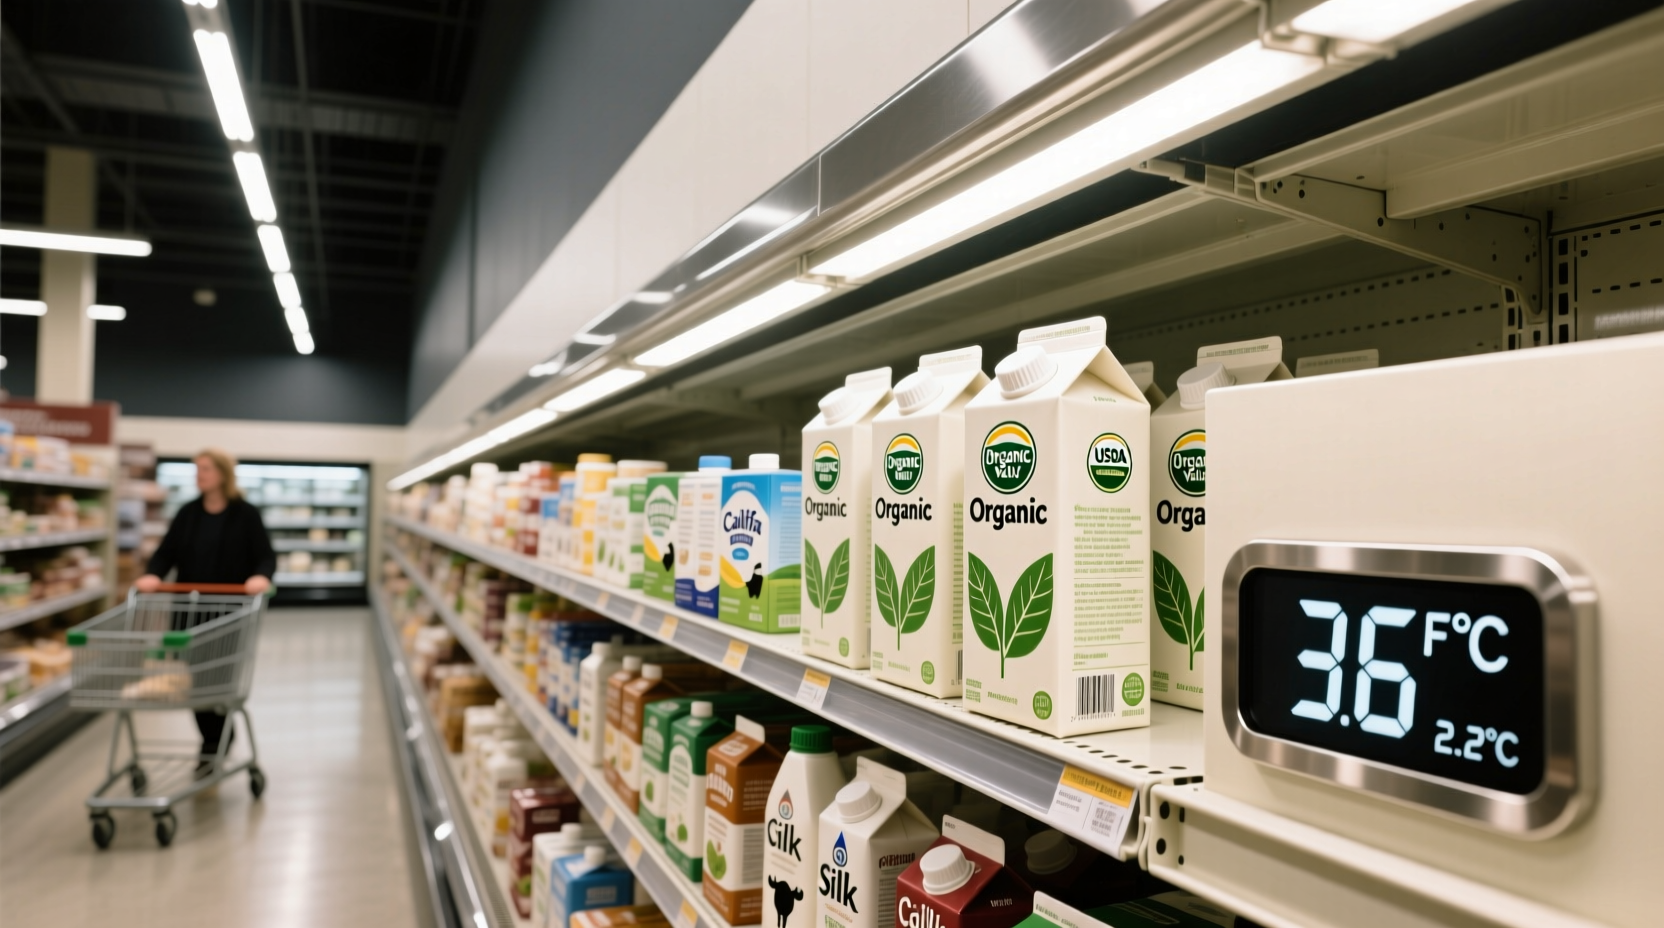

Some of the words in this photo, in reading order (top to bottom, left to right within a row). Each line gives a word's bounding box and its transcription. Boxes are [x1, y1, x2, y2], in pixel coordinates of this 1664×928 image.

[1095, 447, 1127, 464] USDA
[805, 496, 847, 521] Organic
[875, 497, 932, 526] Organic
[969, 496, 1047, 531] Organic
[1156, 499, 1206, 532] Orga
[1423, 611, 1510, 674] F°C
[1290, 598, 1417, 739] 3.6
[1433, 718, 1520, 768] 2.2°C
[818, 863, 859, 914] Silk
